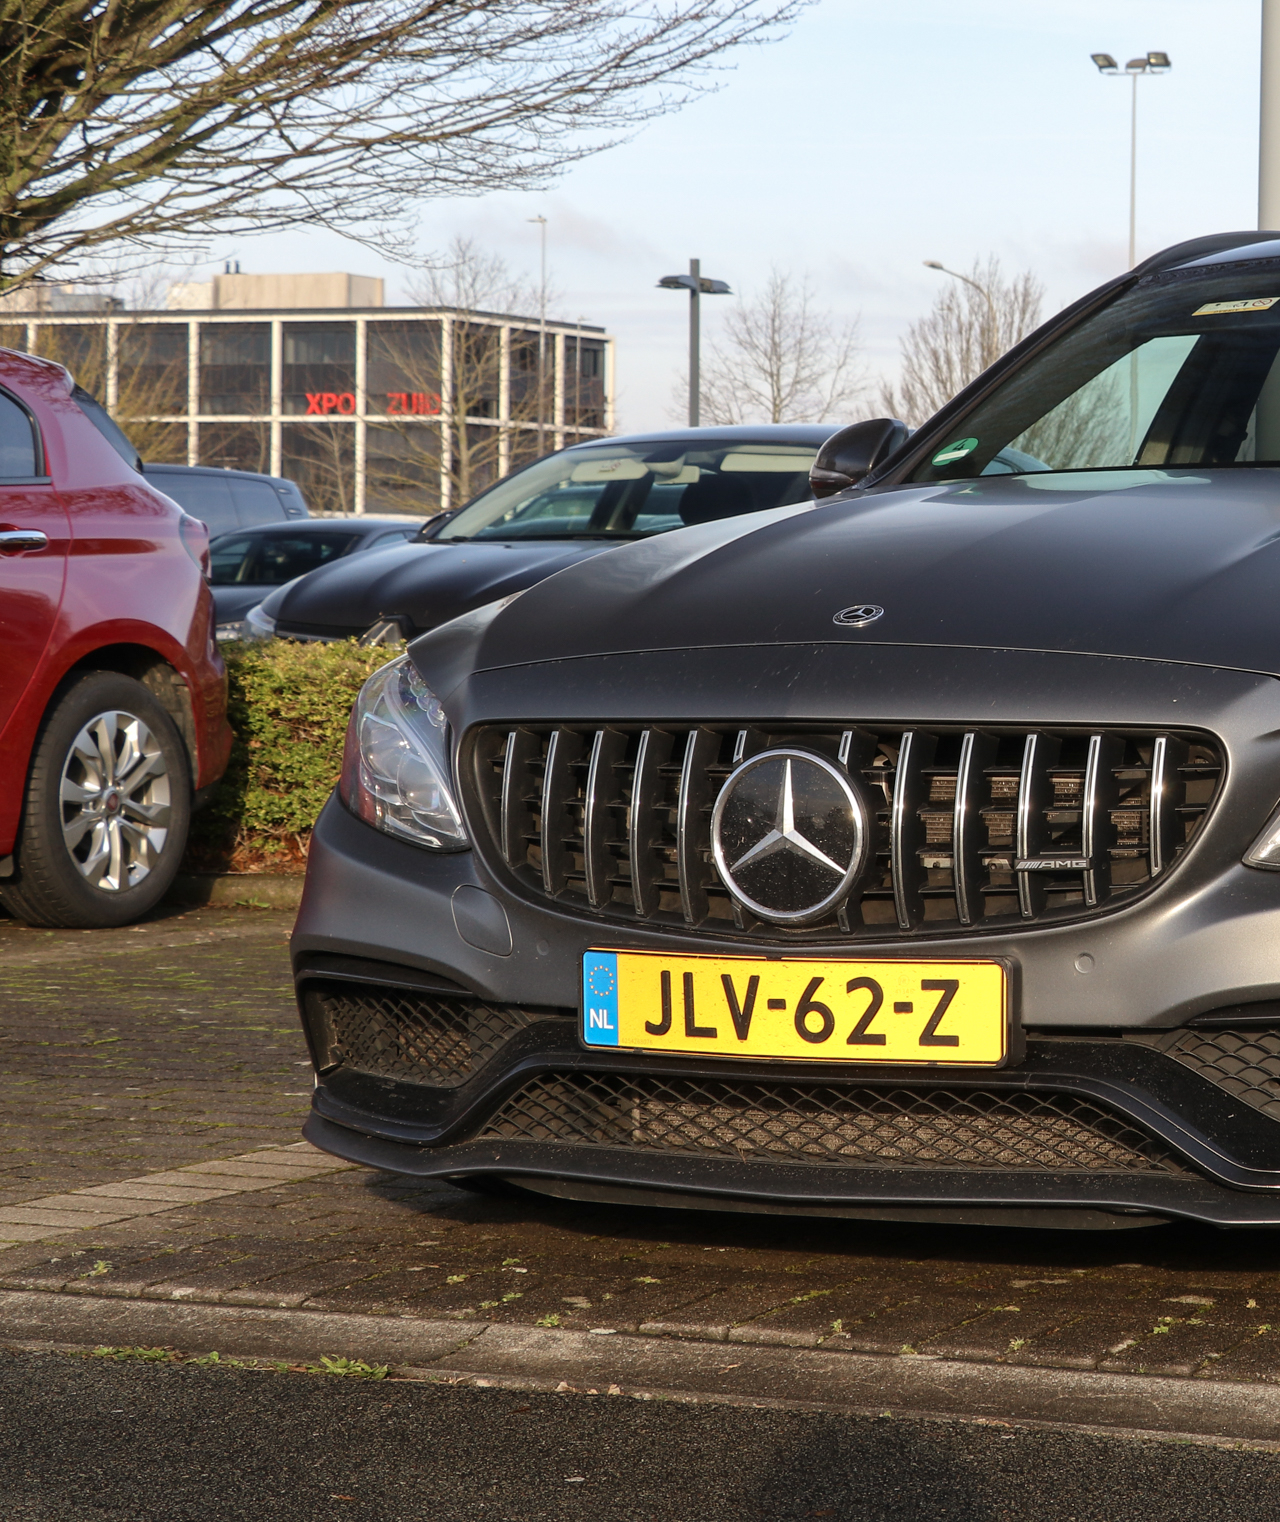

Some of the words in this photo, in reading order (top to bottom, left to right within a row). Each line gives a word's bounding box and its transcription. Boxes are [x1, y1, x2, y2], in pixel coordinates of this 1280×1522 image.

[305, 392, 356, 415] XPO
[1038, 860, 1087, 869] AMG
[589, 1007, 614, 1031] NL
[645, 970, 960, 1048] JLV-62-Z
